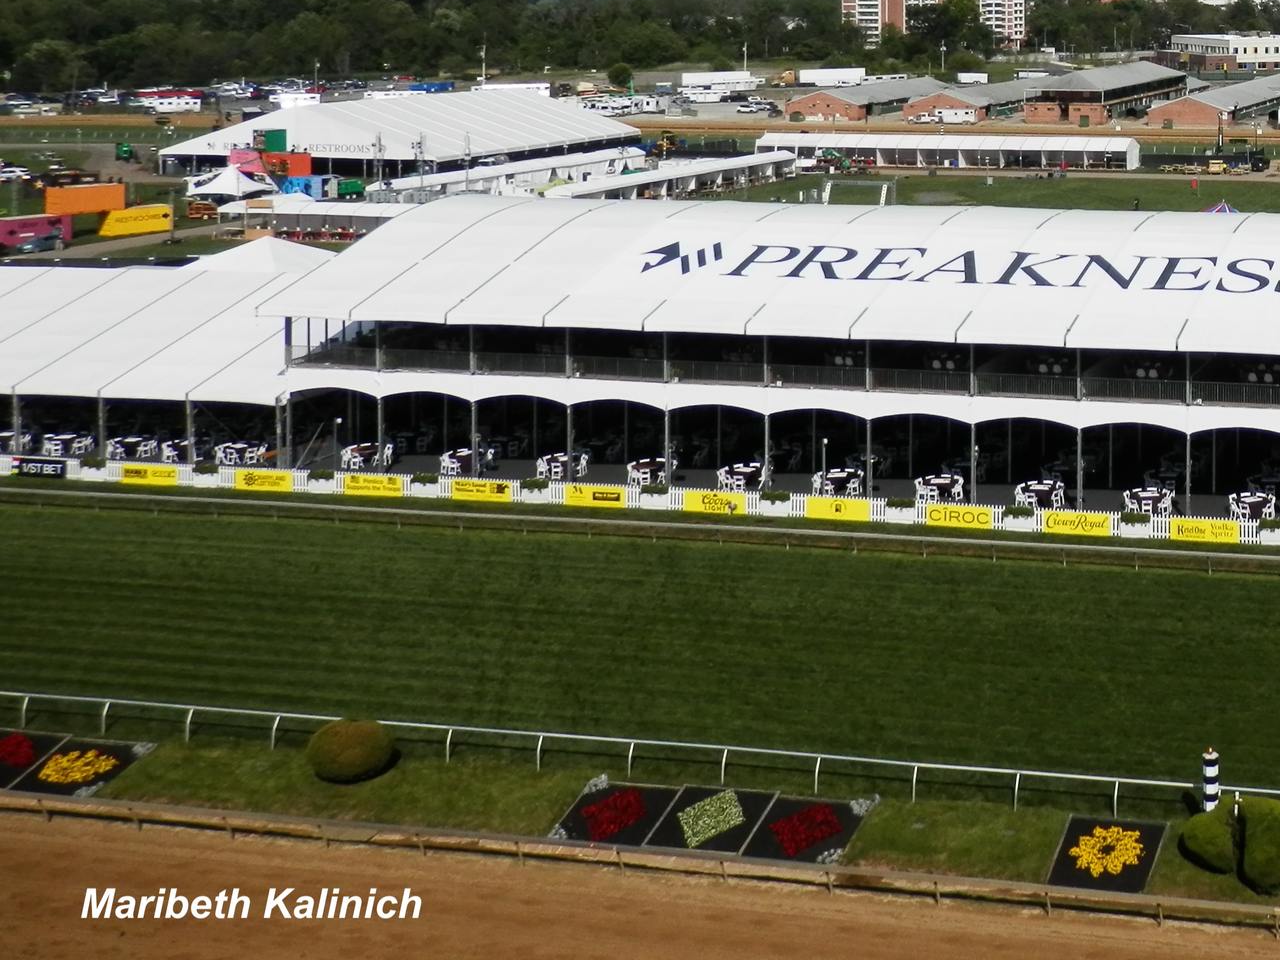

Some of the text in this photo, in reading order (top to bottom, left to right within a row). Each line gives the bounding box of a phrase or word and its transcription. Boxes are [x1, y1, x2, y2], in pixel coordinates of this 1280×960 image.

[308, 143, 371, 155] RESTROOMS
[44, 463, 64, 475] BET
[702, 493, 732, 507] Coors
[1046, 512, 1109, 533] Crown Royal
[1210, 522, 1235, 531] Vodka
[1210, 530, 1234, 539] Spritz
